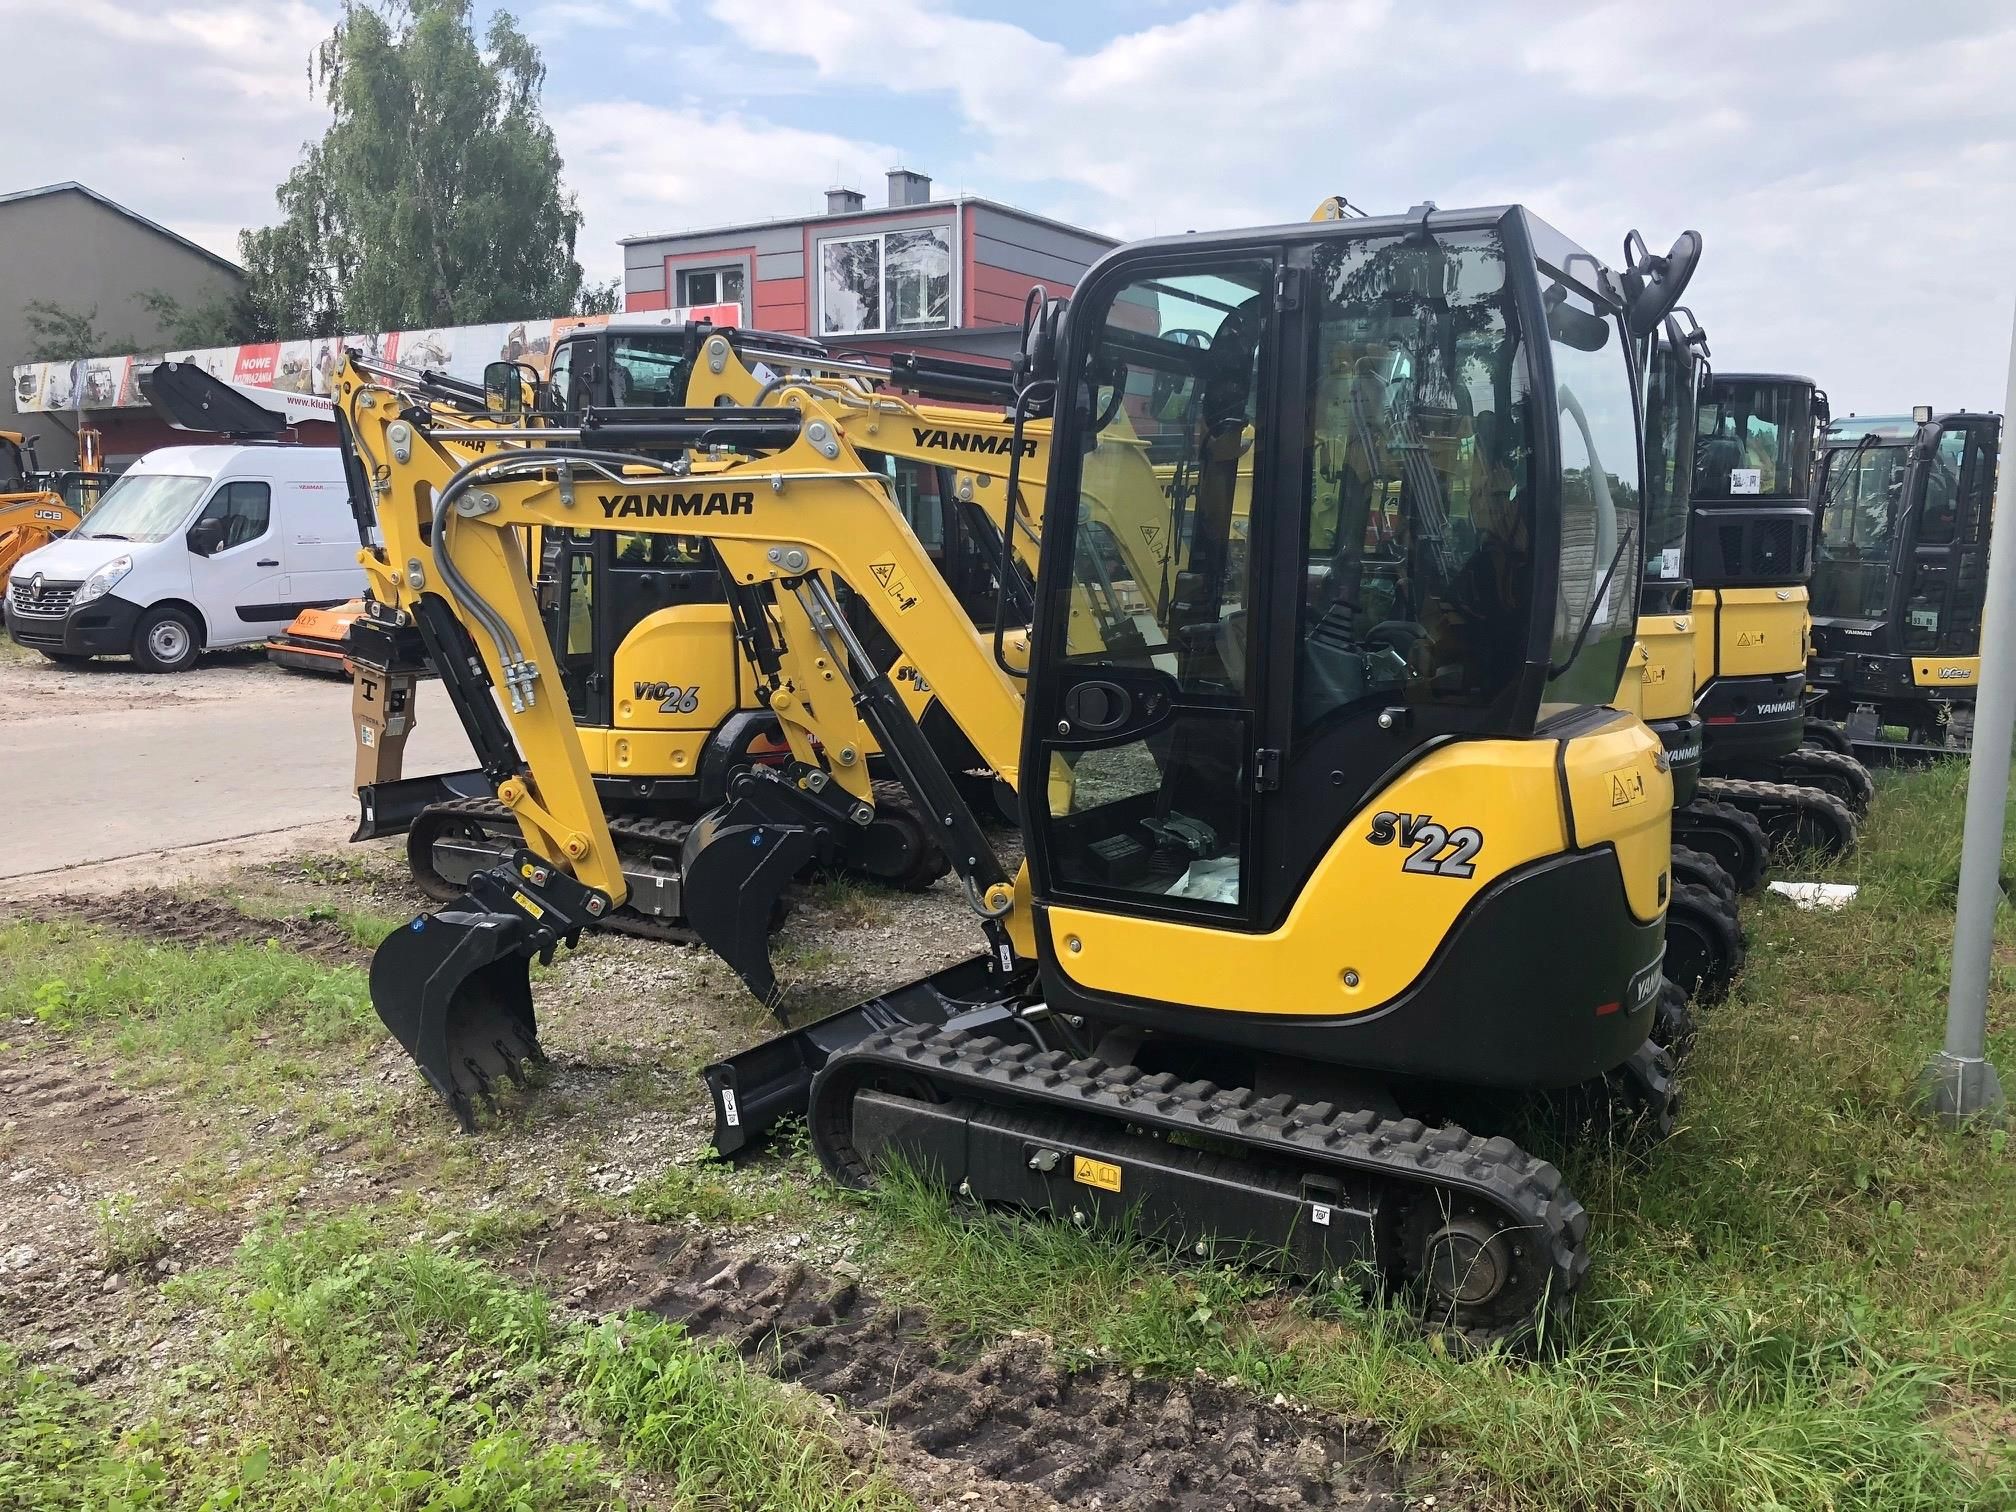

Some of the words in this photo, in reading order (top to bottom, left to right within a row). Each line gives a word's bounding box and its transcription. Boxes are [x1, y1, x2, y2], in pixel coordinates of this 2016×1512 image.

[241, 357, 272, 370] NOWE
[912, 427, 1038, 458] YANMAR
[598, 492, 755, 519] YANMAR
[35, 510, 62, 520] JCB
[1757, 701, 1796, 715] YANMAR
